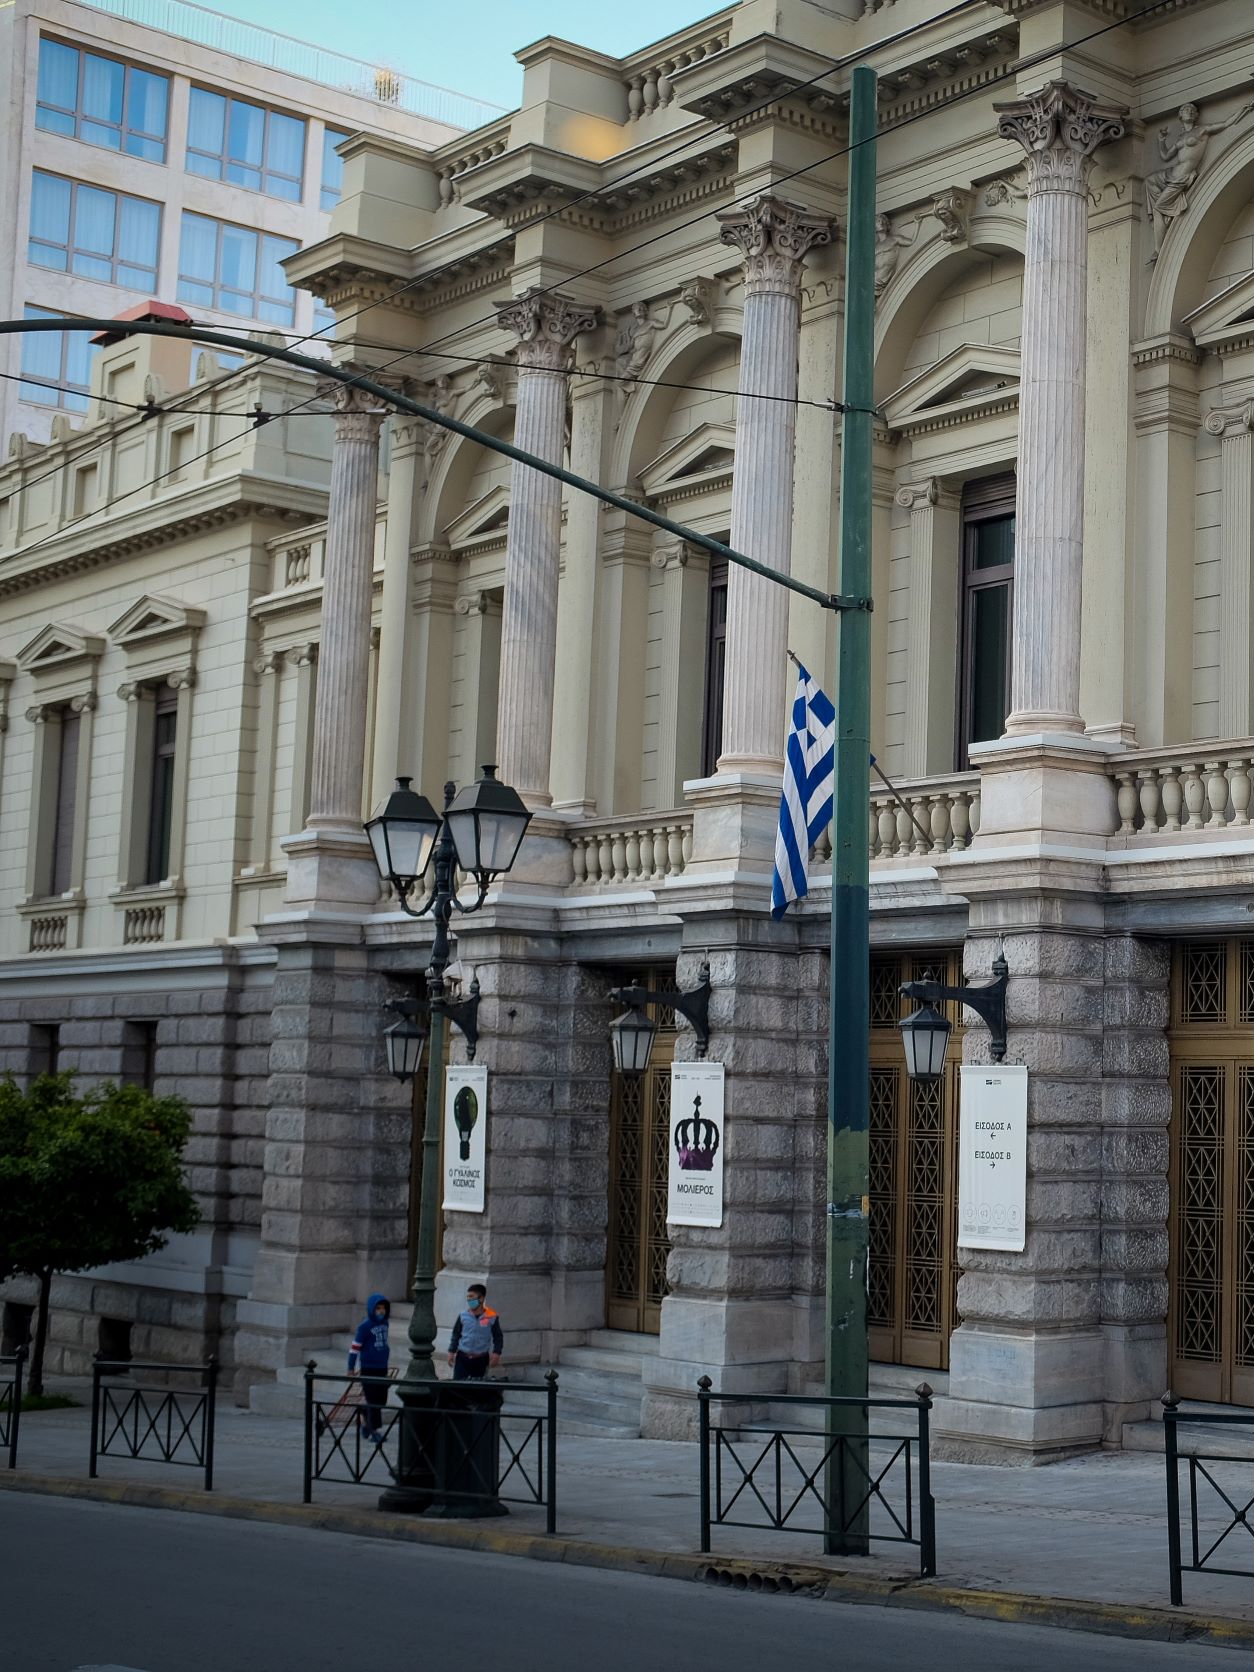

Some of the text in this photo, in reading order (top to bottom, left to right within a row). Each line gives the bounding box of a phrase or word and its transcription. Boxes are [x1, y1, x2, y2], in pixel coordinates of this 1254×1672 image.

[975, 1121, 1012, 1131] ΕΙΣΟΔΟΣ Α
[974, 1150, 1012, 1160] ΕΙΣΟΔΟΣ Β
[676, 1183, 715, 1195] ΜΟΛΙΕΡΟΣ
